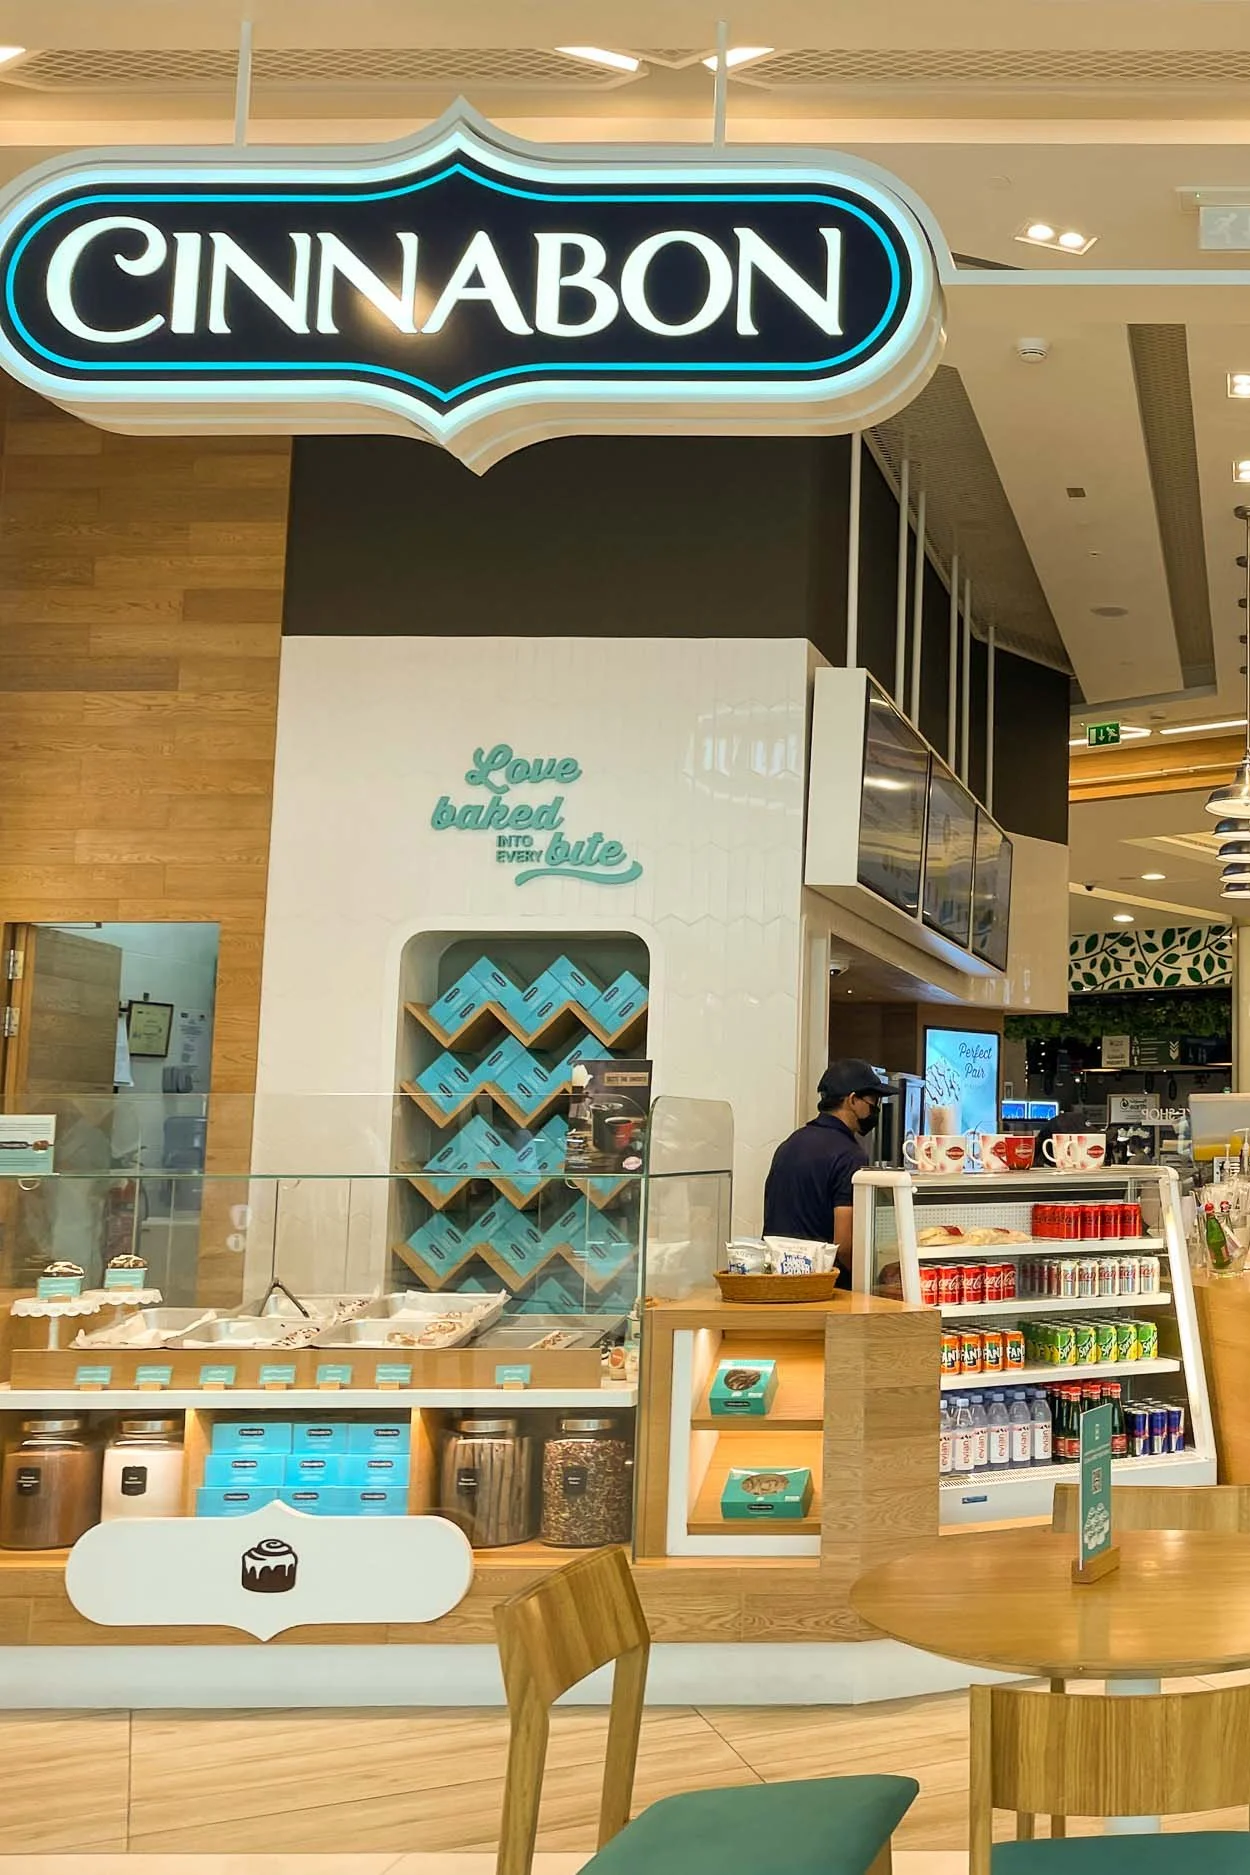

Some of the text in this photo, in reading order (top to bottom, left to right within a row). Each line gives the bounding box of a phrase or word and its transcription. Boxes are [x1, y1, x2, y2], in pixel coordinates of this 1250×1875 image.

[46, 215, 845, 344] CINNABON
[464, 743, 583, 795] Love
[430, 796, 565, 831] baked
[496, 835, 534, 848] INTO
[545, 831, 627, 866] bite
[496, 850, 543, 863] EVERY
[958, 1042, 993, 1063] Perfect
[964, 1063, 986, 1079] Pair
[998, 1433, 1006, 1457] evian
